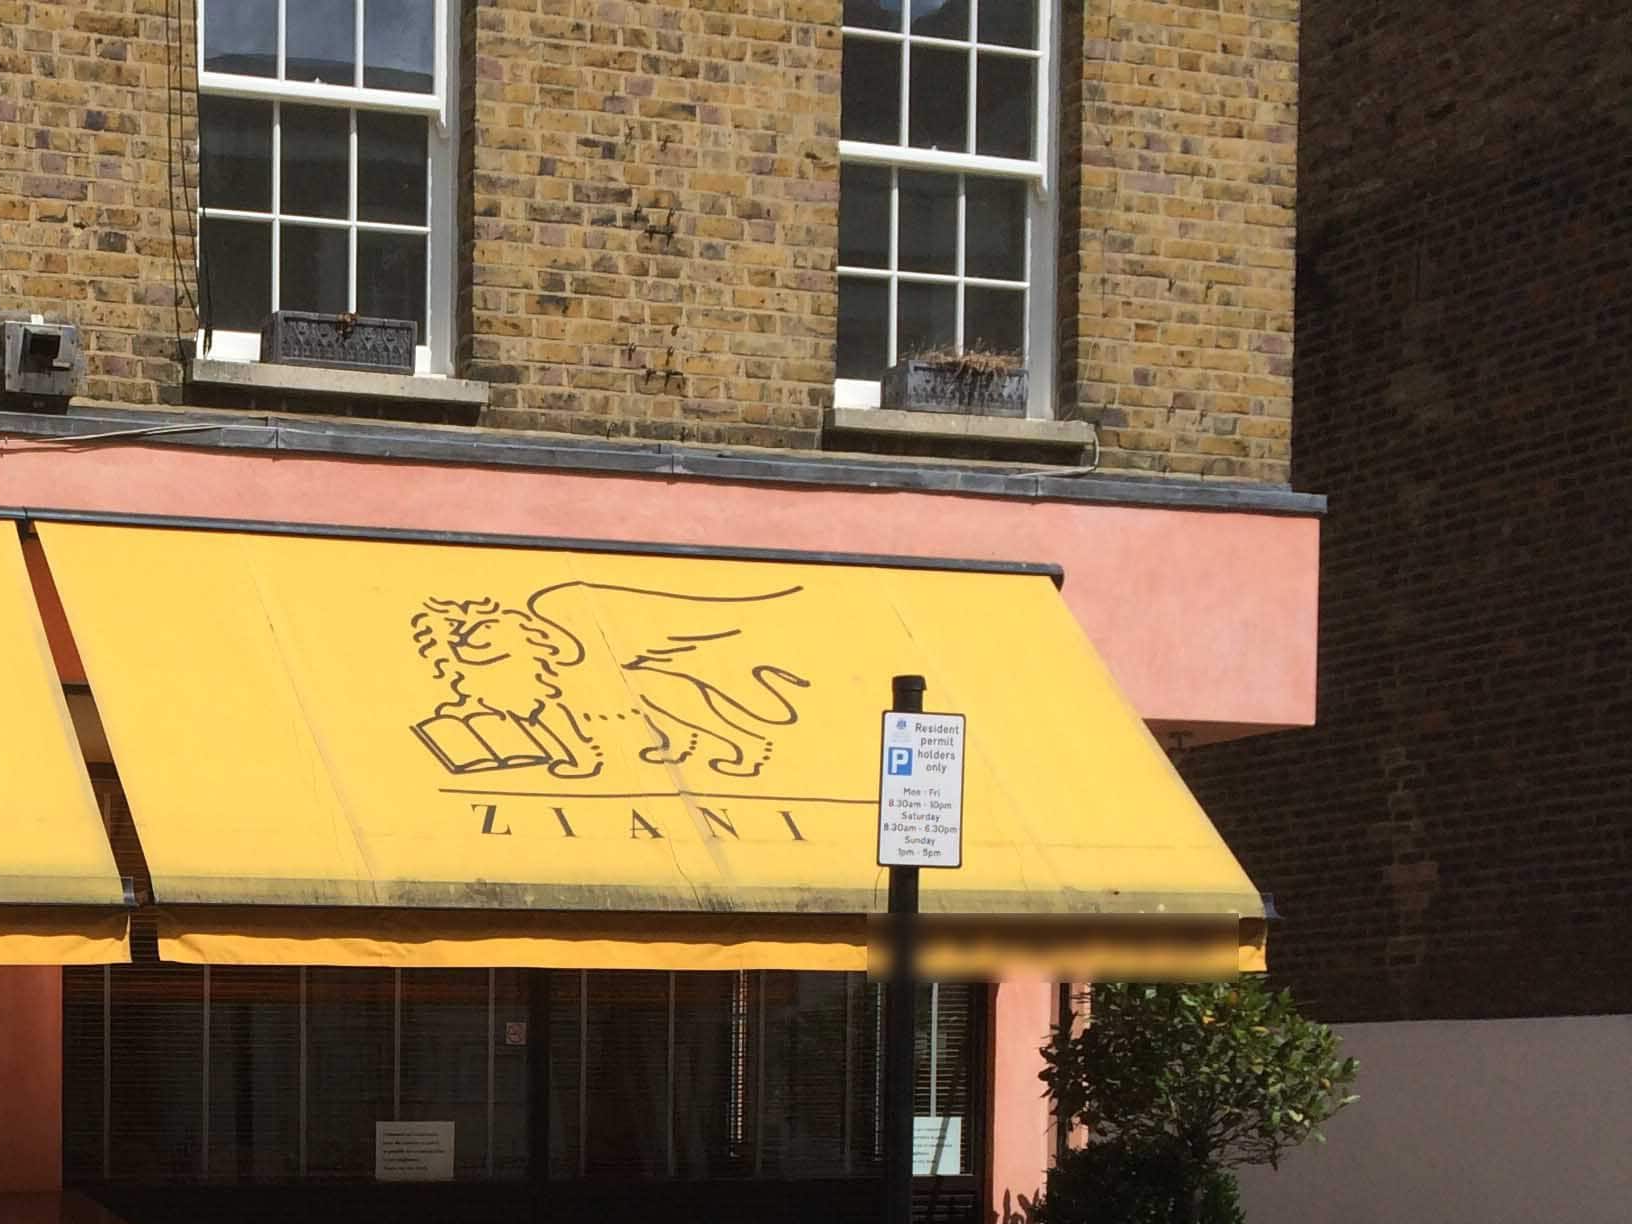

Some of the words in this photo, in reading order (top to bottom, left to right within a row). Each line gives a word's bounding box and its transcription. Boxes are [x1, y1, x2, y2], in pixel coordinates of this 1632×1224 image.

[915, 723, 960, 735] Resident
[921, 736, 954, 747] permit
[917, 750, 956, 760] holders
[890, 749, 910, 773] P
[926, 763, 947, 774] only
[904, 787, 920, 796] Mon
[902, 812, 940, 822] Saturday
[470, 803, 808, 842] ZIANI
[905, 836, 935, 846] Sunday
[899, 848, 914, 856] 1pm
[923, 849, 941, 857] 5pm
